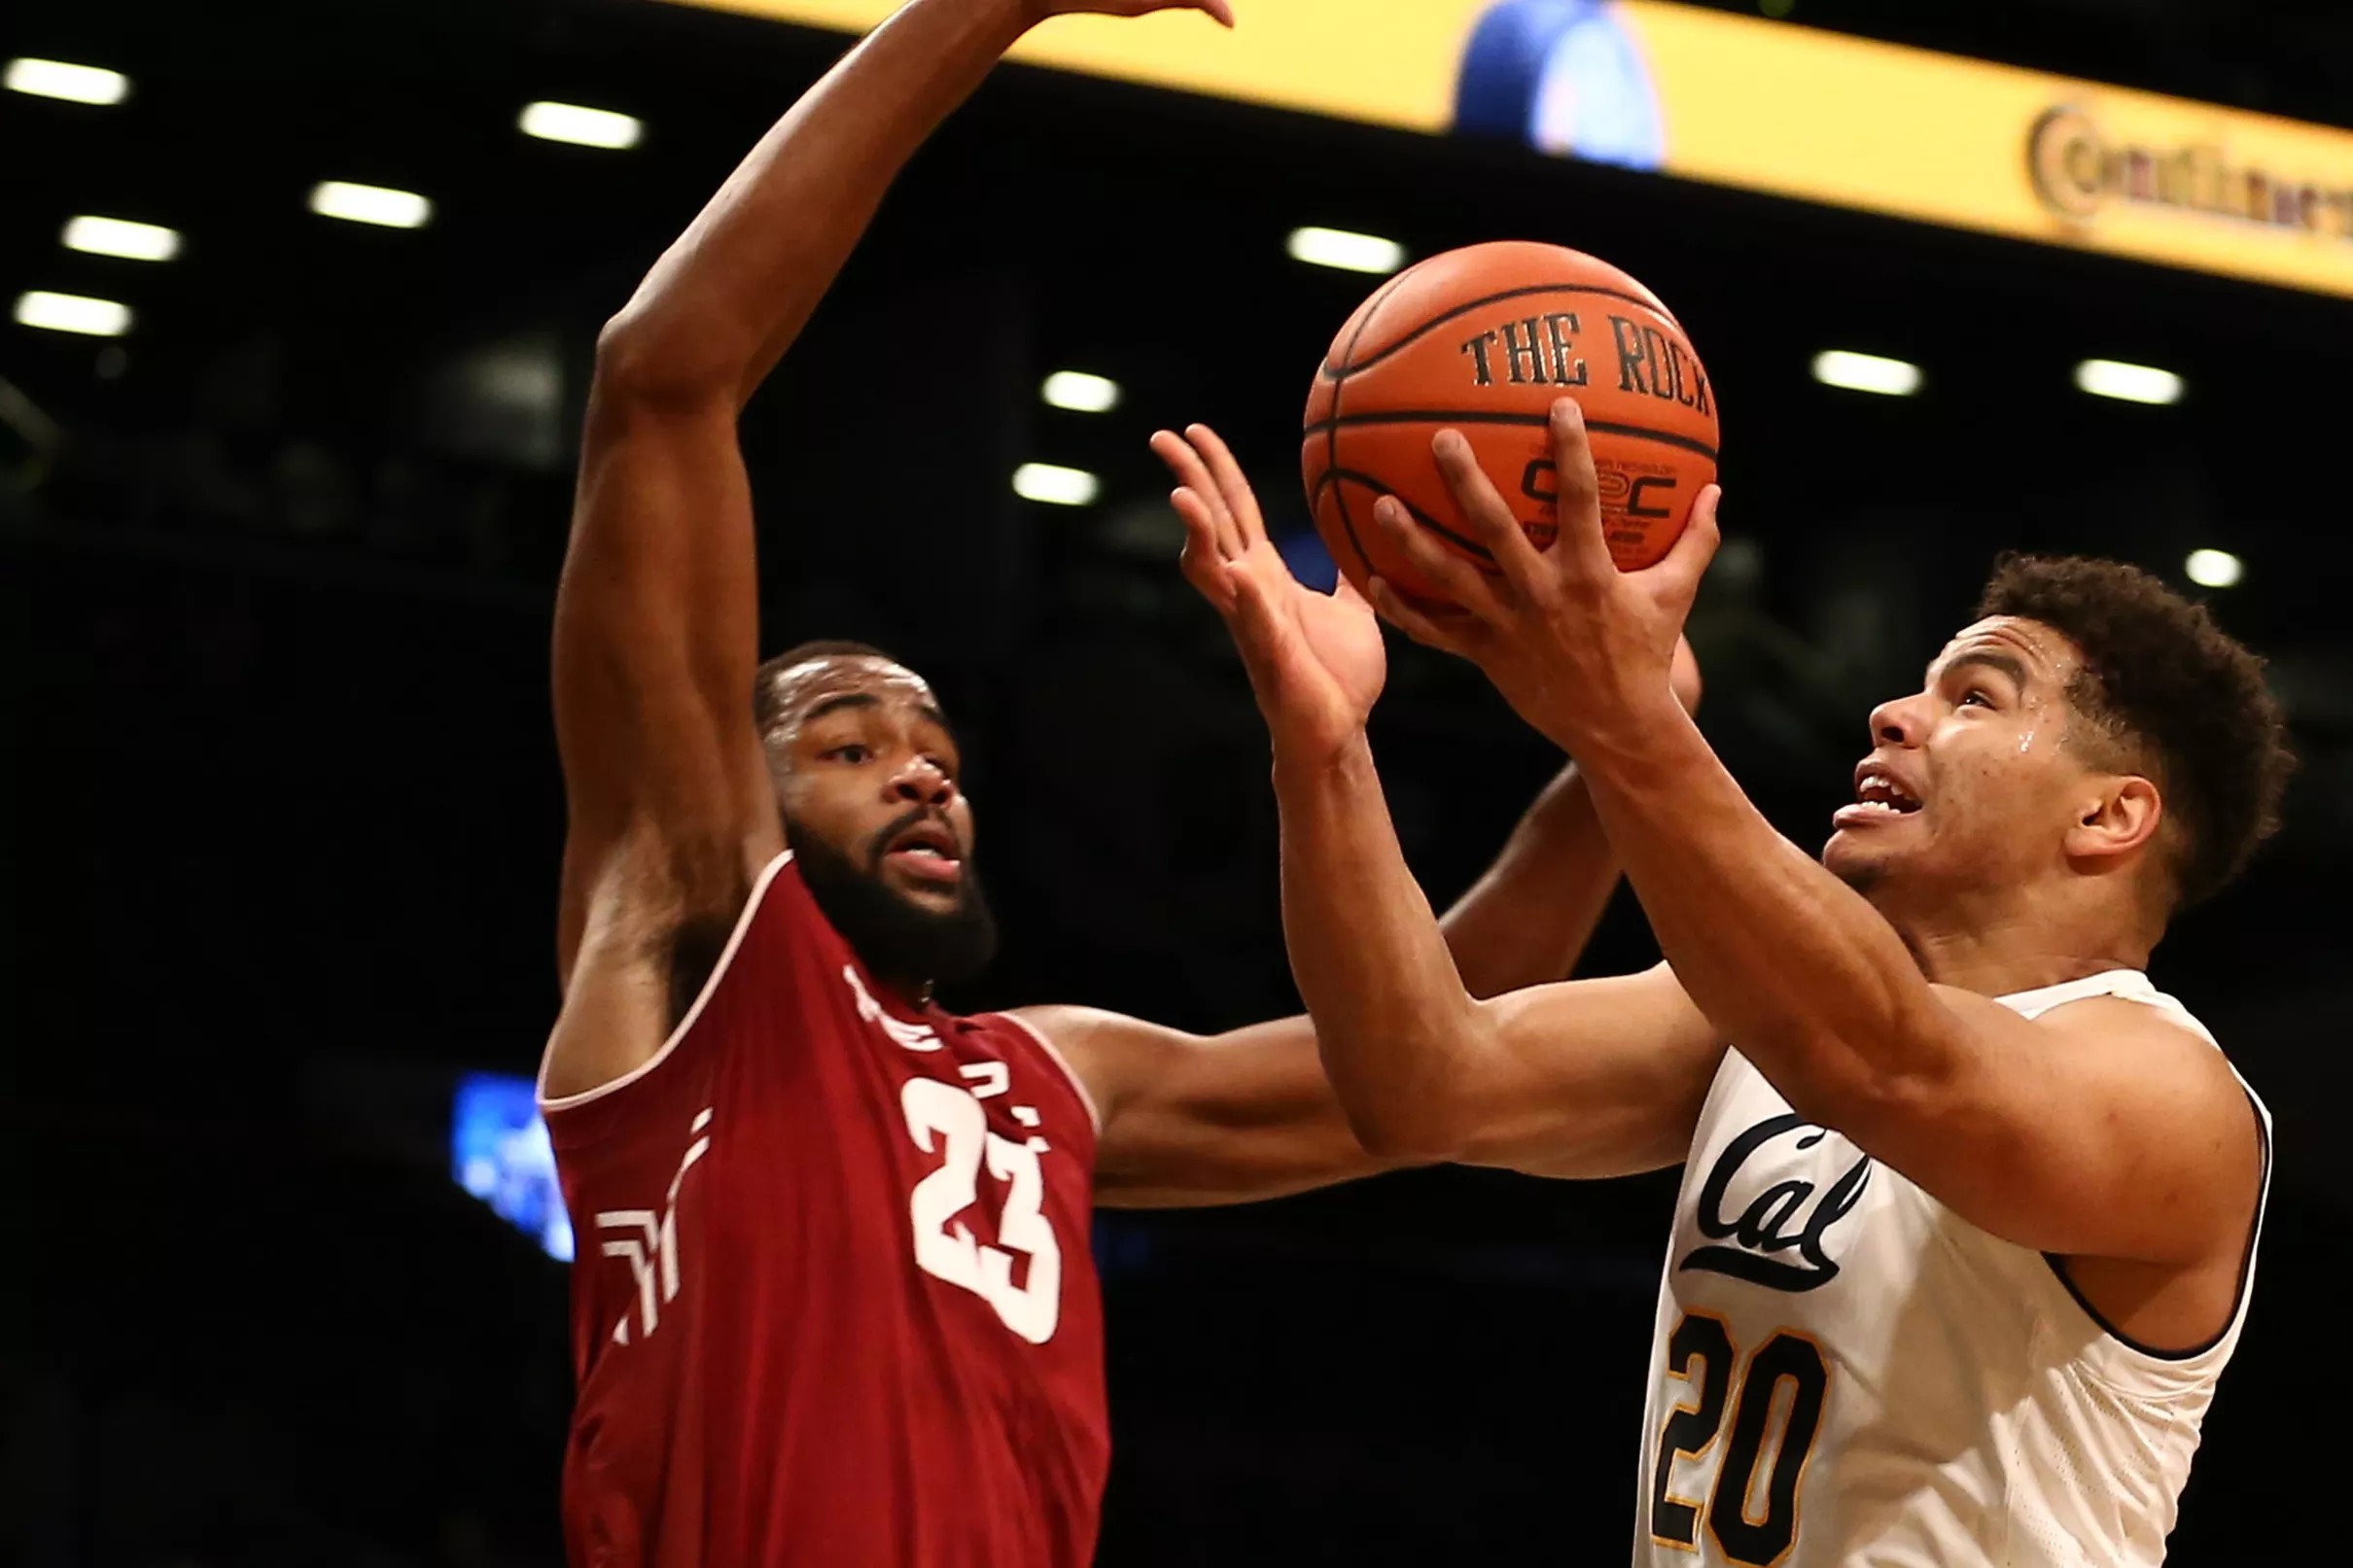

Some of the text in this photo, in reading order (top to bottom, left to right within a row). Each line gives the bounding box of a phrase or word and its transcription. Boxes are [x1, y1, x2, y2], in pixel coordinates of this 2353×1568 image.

[1461, 312, 1709, 416] THE ROCK
[900, 1077, 1062, 1344] 23
[1679, 1112, 1872, 1292] Cal
[1650, 1306, 1830, 1568] 20
